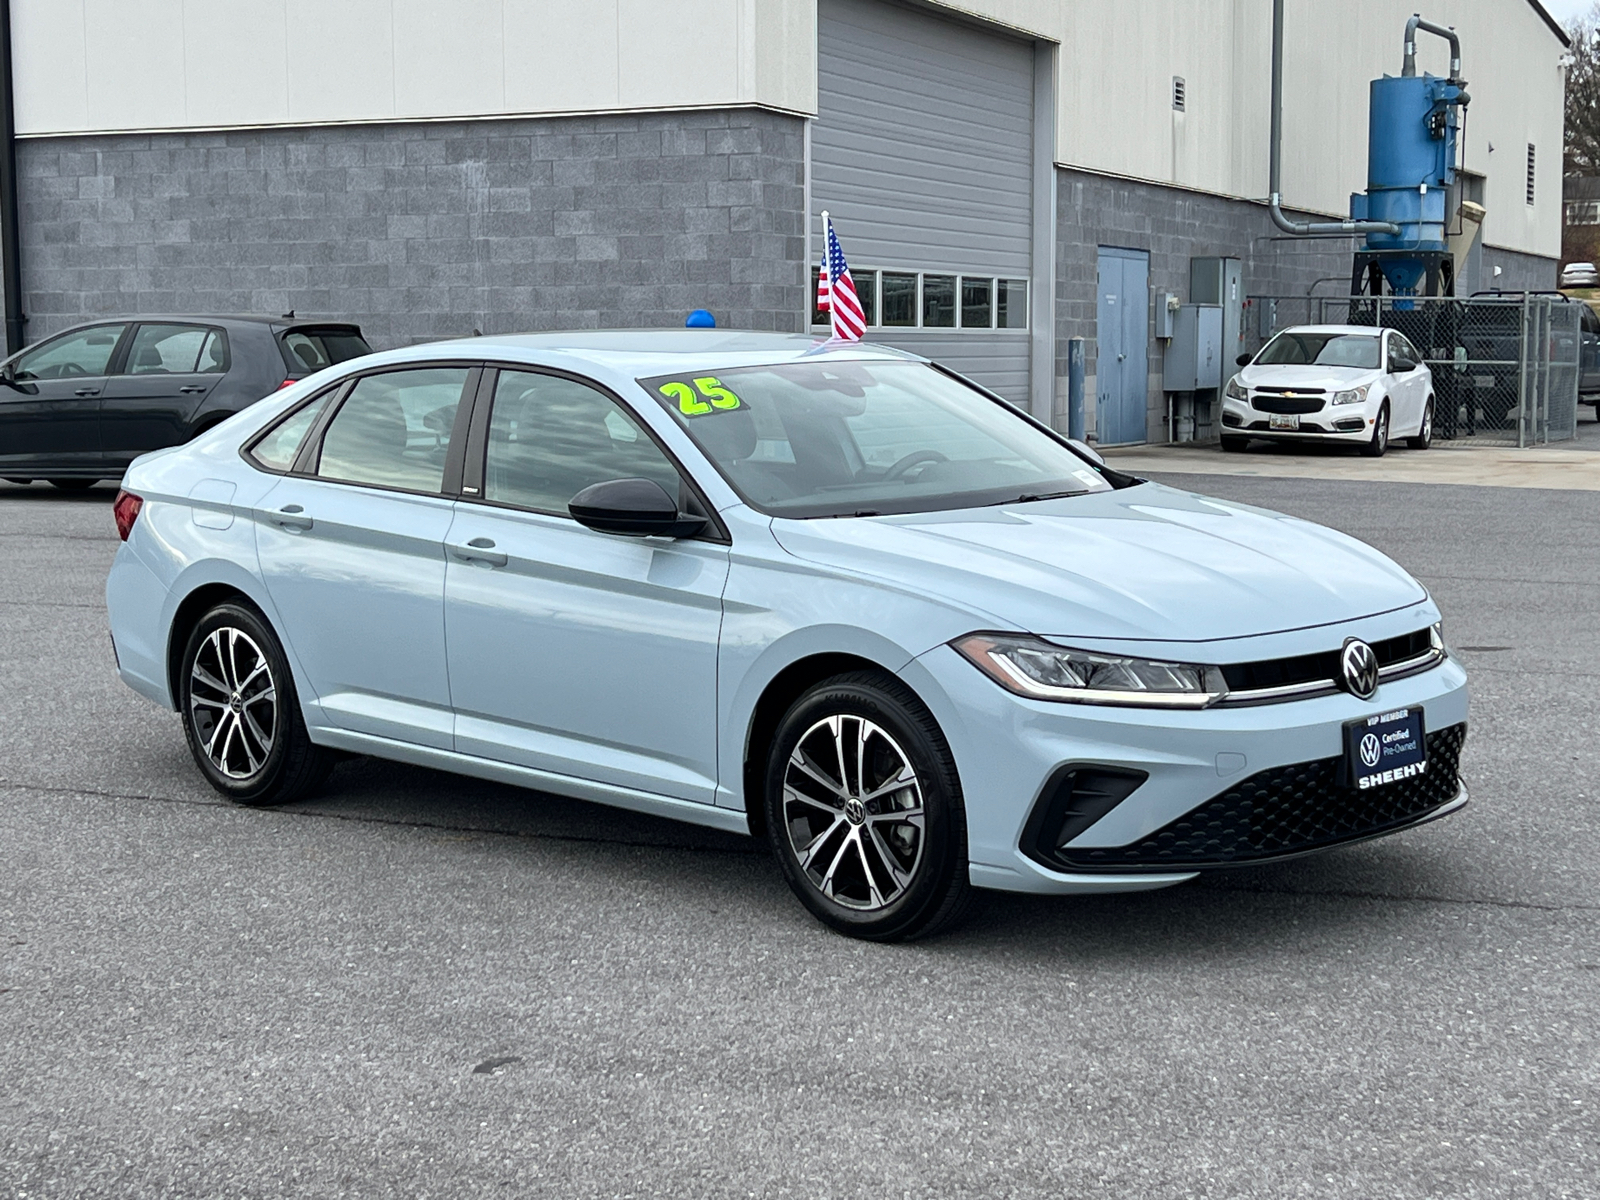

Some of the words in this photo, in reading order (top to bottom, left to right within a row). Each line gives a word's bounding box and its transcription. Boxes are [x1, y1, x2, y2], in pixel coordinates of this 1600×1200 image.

[659, 377, 740, 415] 25
[1367, 716, 1379, 726] VIP
[1380, 709, 1408, 723] MEMBER
[1382, 728, 1410, 743] Certified
[1383, 740, 1417, 756] Pre-Owned
[1359, 761, 1427, 789] SHEEHY
